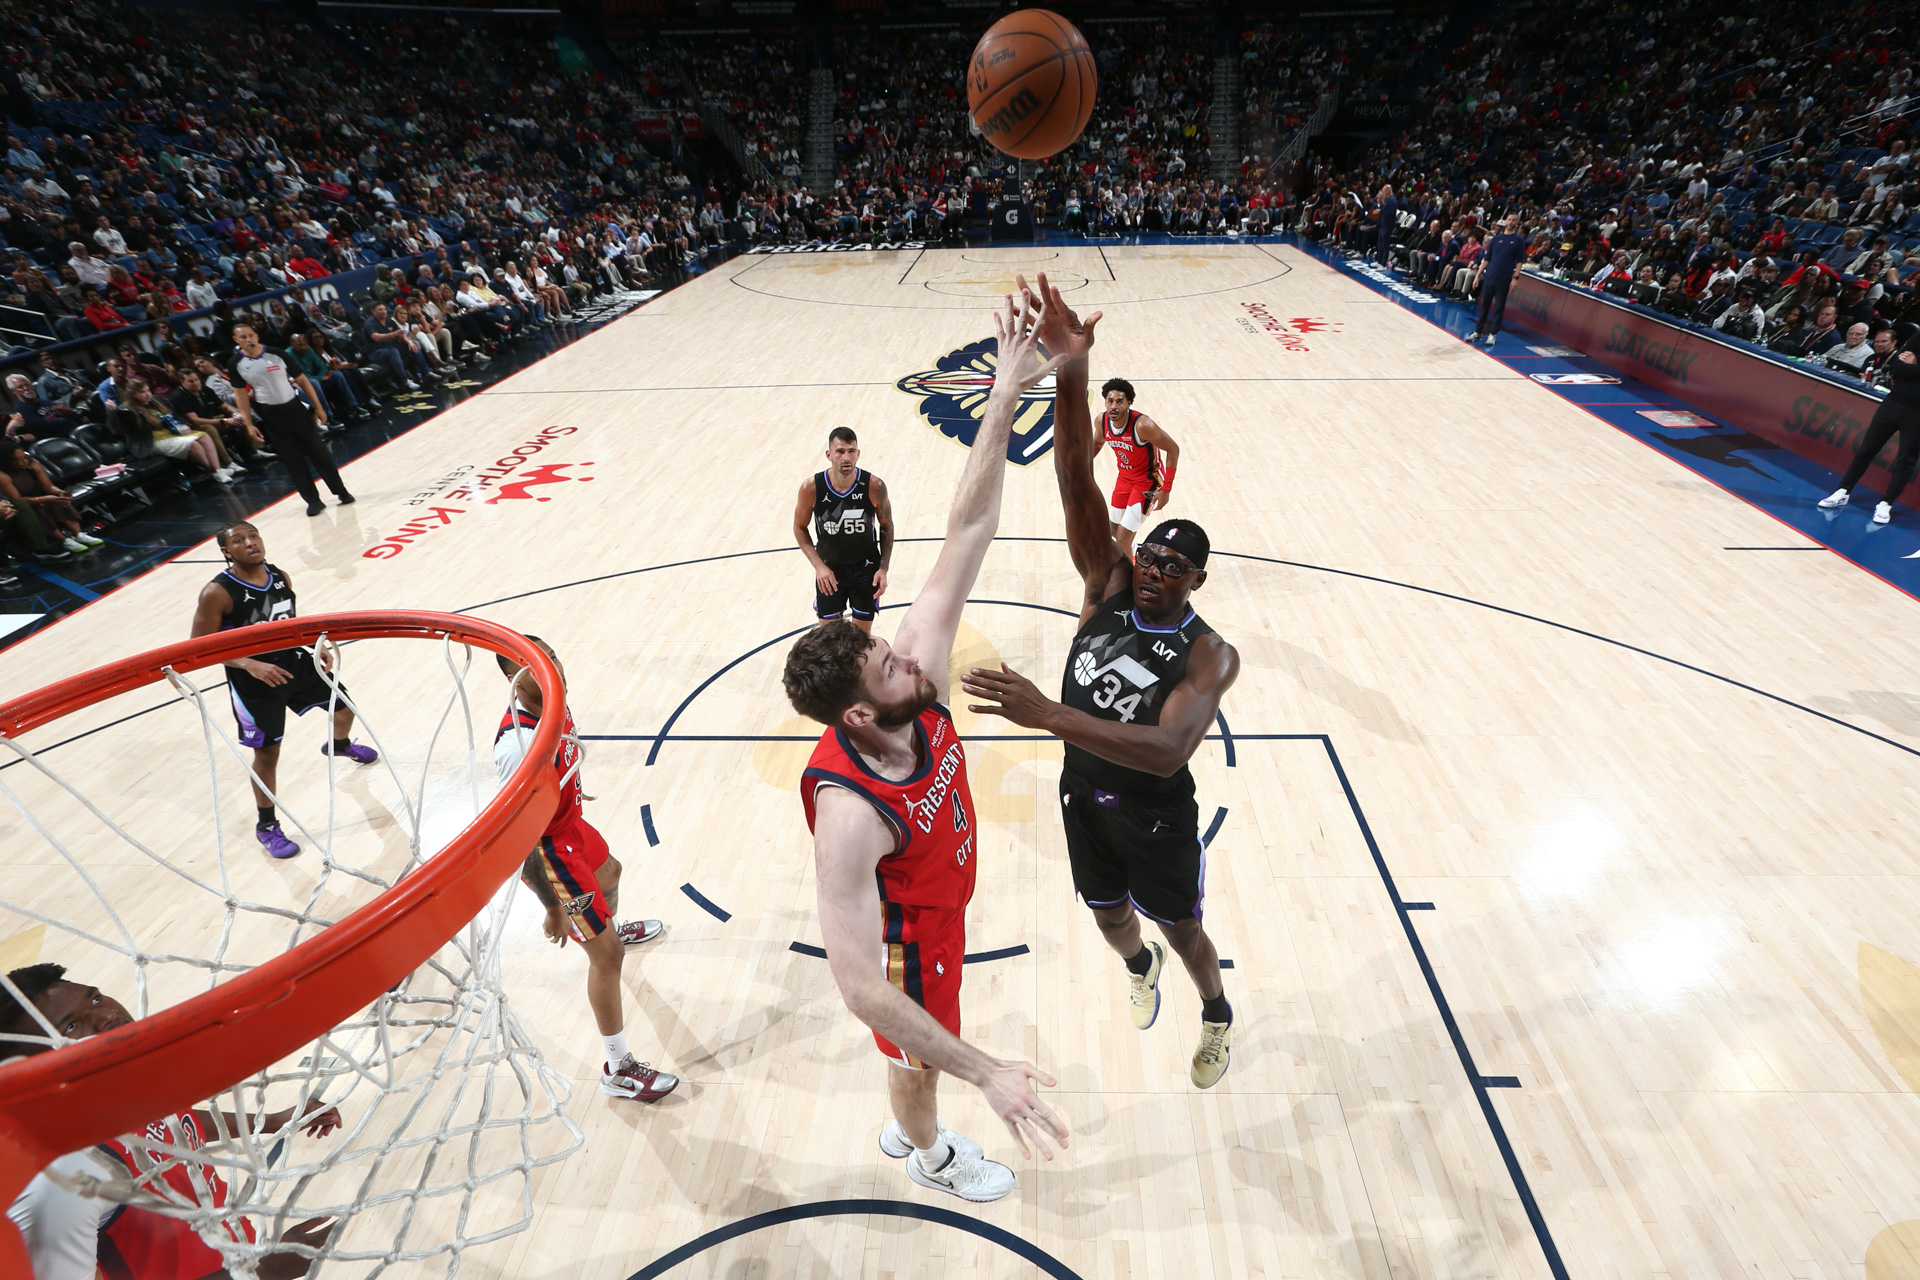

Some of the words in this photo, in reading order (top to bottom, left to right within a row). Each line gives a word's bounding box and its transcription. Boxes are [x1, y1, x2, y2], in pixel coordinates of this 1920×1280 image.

[1005, 209, 1019, 225] G
[747, 241, 925, 254] PELICANS
[1604, 322, 1699, 385] SEATGEEK
[444, 425, 578, 501] SMOOTHIE
[403, 465, 474, 506] CENTER
[844, 519, 866, 535] 55
[1152, 640, 1178, 662] LVT
[1093, 673, 1143, 723] 34
[931, 716, 946, 748] NEWAGE
[936, 723, 948, 748] PRODUCTS
[916, 742, 965, 834] CRESCENT
[952, 788, 969, 833] 4
